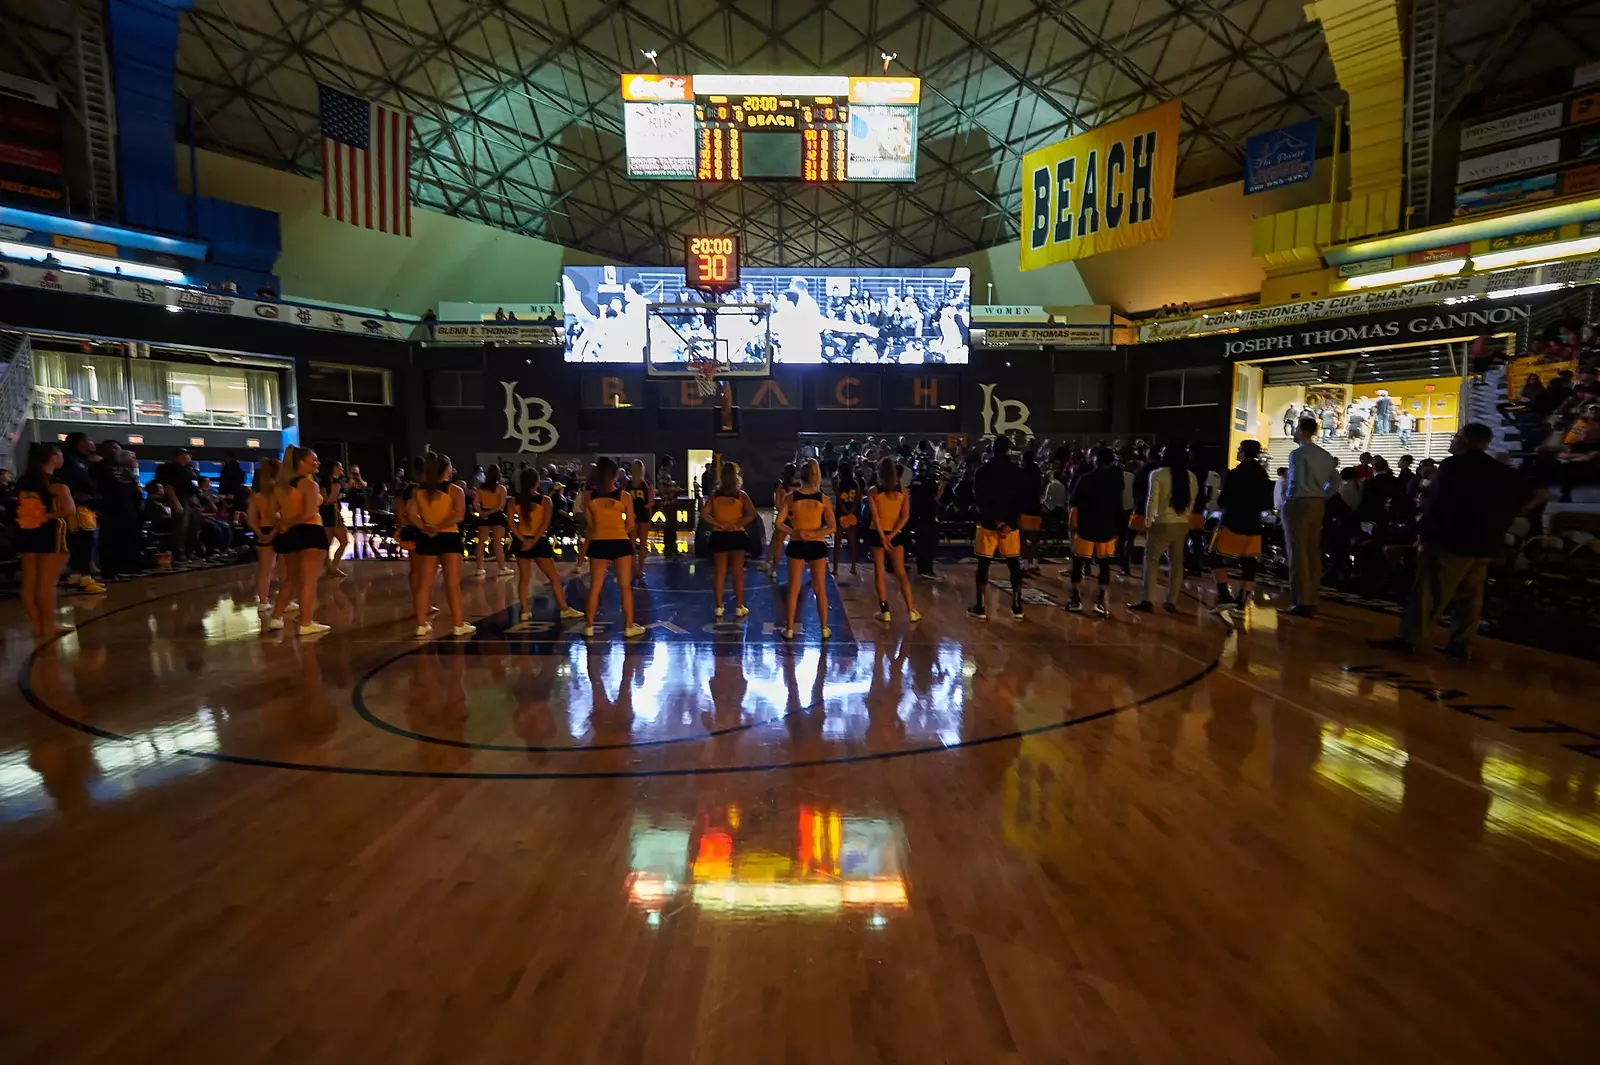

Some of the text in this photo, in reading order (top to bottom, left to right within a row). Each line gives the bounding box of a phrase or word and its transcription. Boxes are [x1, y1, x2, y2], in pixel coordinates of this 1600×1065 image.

[742, 96, 777, 111] 20:00
[747, 114, 795, 127] BEACH
[1030, 130, 1159, 251] BEACH
[691, 238, 732, 254] 20:00
[699, 255, 727, 281] 30
[1206, 278, 1470, 326] COMMISSIONER'S CUP CHAMPIONS
[984, 307, 1031, 315] WOMEN
[438, 327, 468, 335] GLENN
[470, 327, 479, 335] E.
[481, 327, 519, 335] THOMAS
[988, 330, 1019, 338] GLENN
[1022, 330, 1030, 338] E.
[1032, 330, 1070, 338] THOMAS
[1223, 304, 1532, 358] JOSEPH THOMAS GANNON
[500, 380, 561, 454] LB
